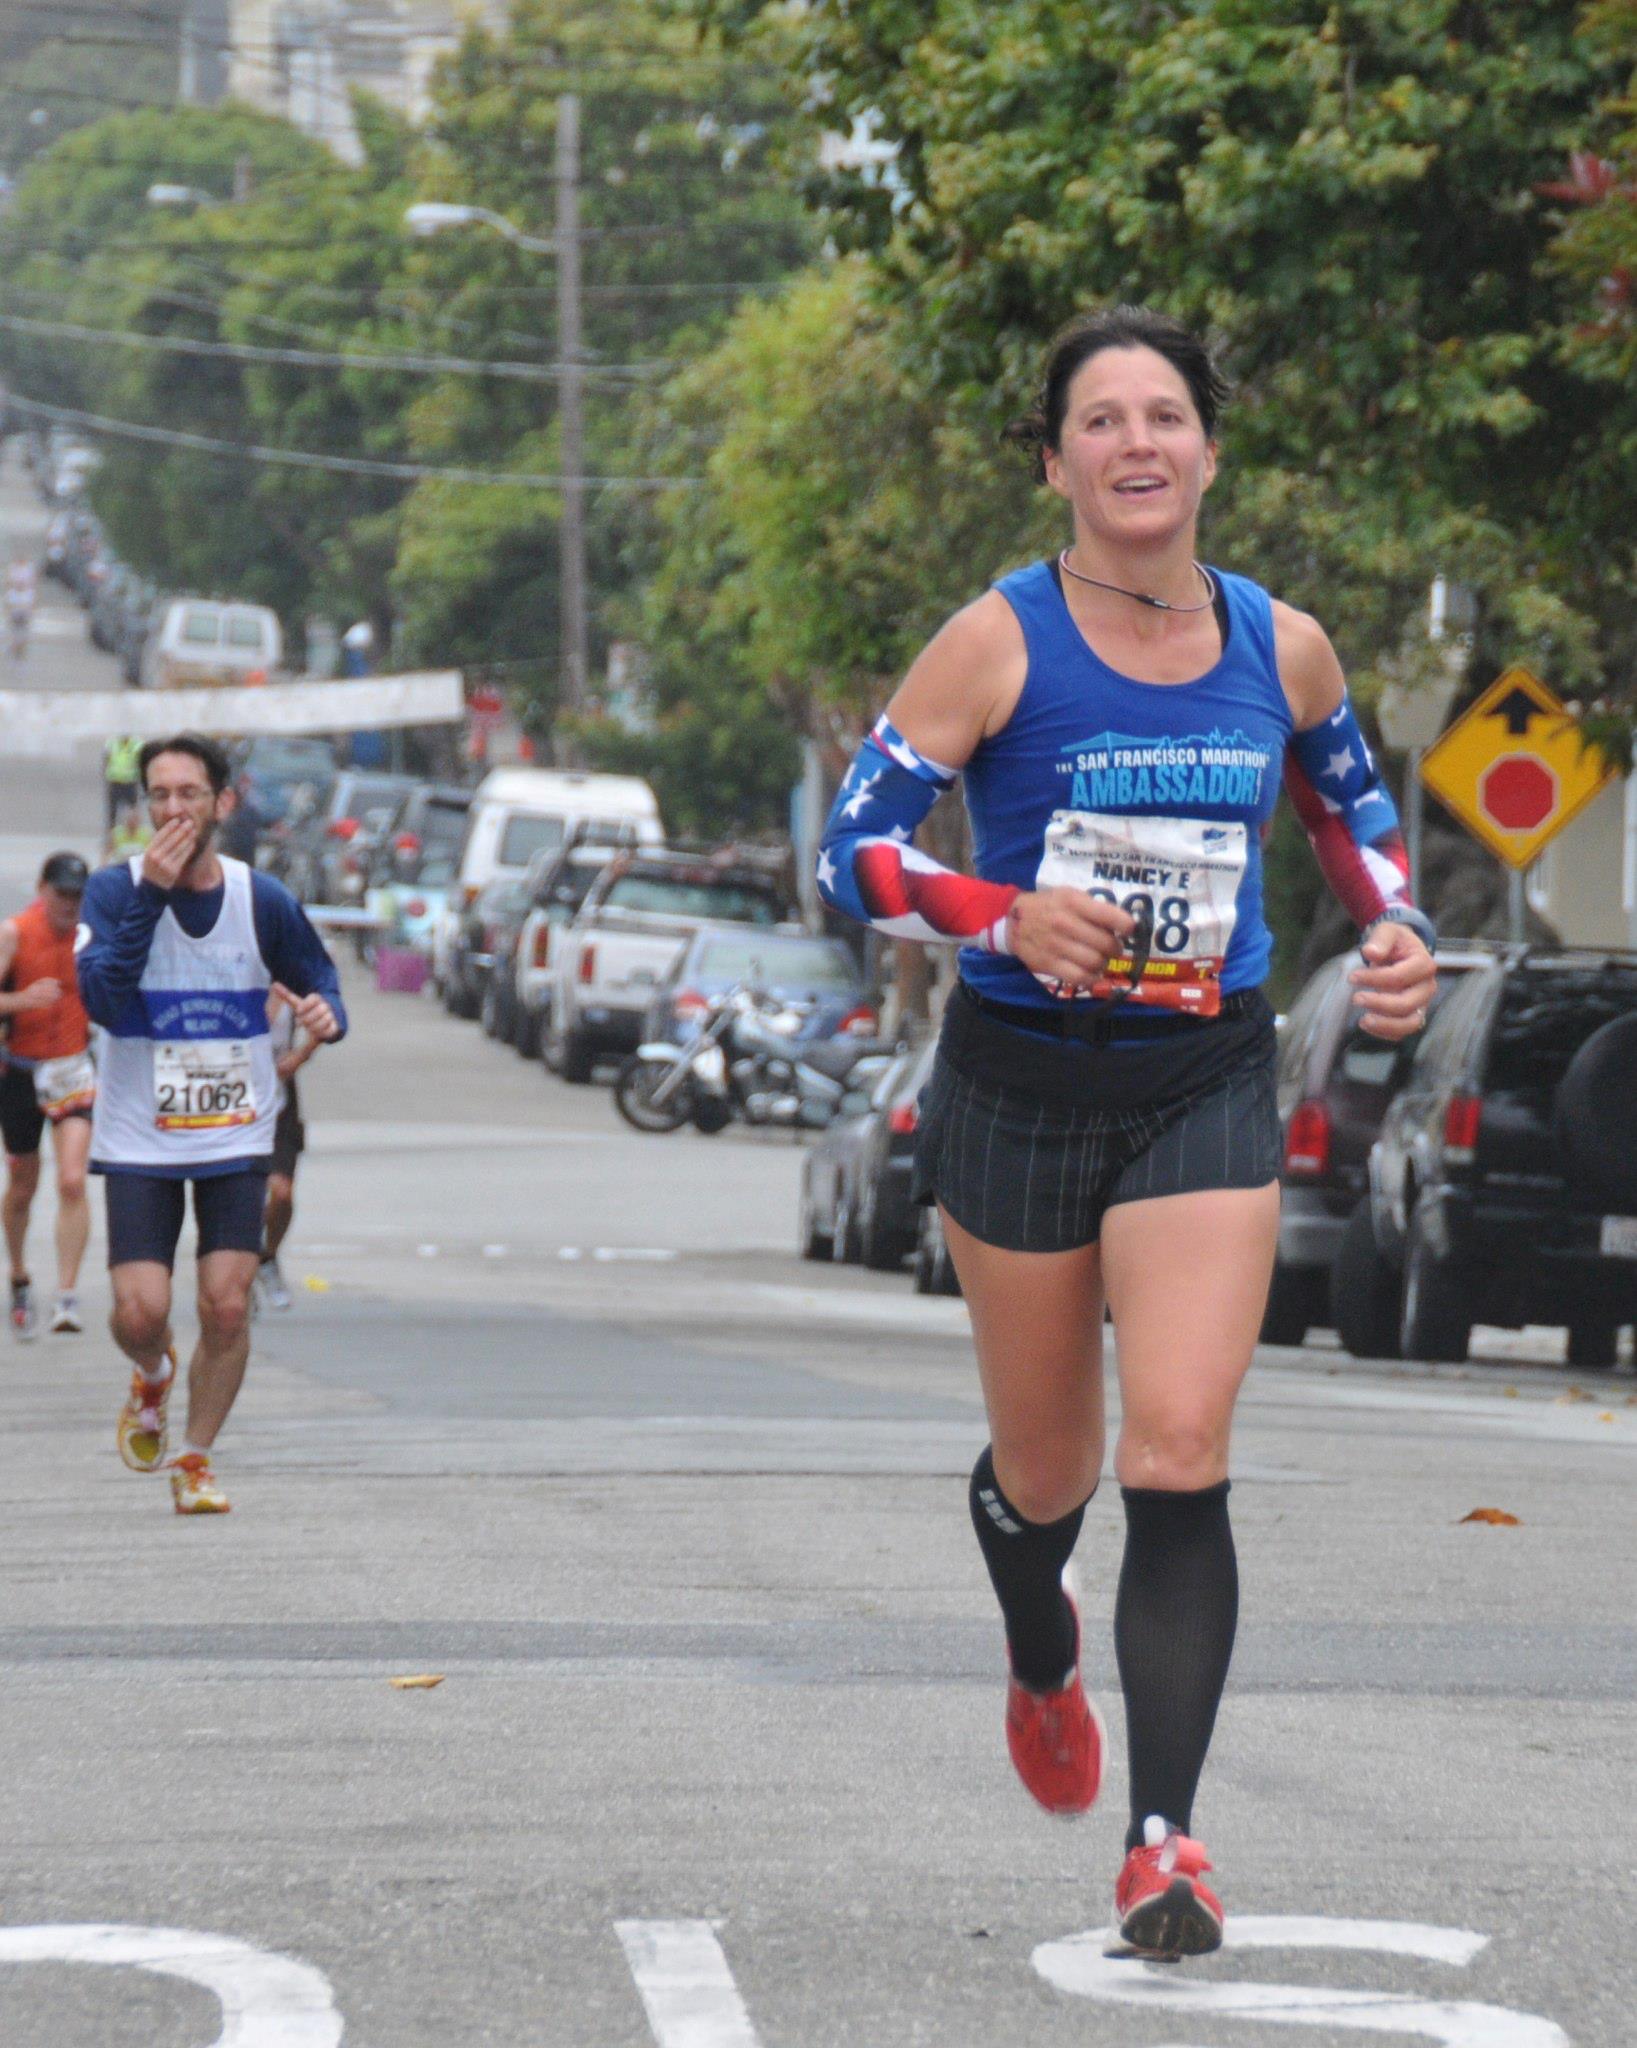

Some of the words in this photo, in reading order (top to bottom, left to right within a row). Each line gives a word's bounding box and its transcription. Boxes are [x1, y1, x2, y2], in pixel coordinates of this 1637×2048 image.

[1077, 752, 1108, 771] SAN
[1114, 748, 1197, 769] FRANCISCO
[1201, 748, 1267, 768] MARATHON
[1070, 766, 1257, 807] AMBASSADOR
[1093, 861, 1171, 887] NANCY
[1178, 872, 1191, 889] E
[158, 1080, 250, 1113] 21062
